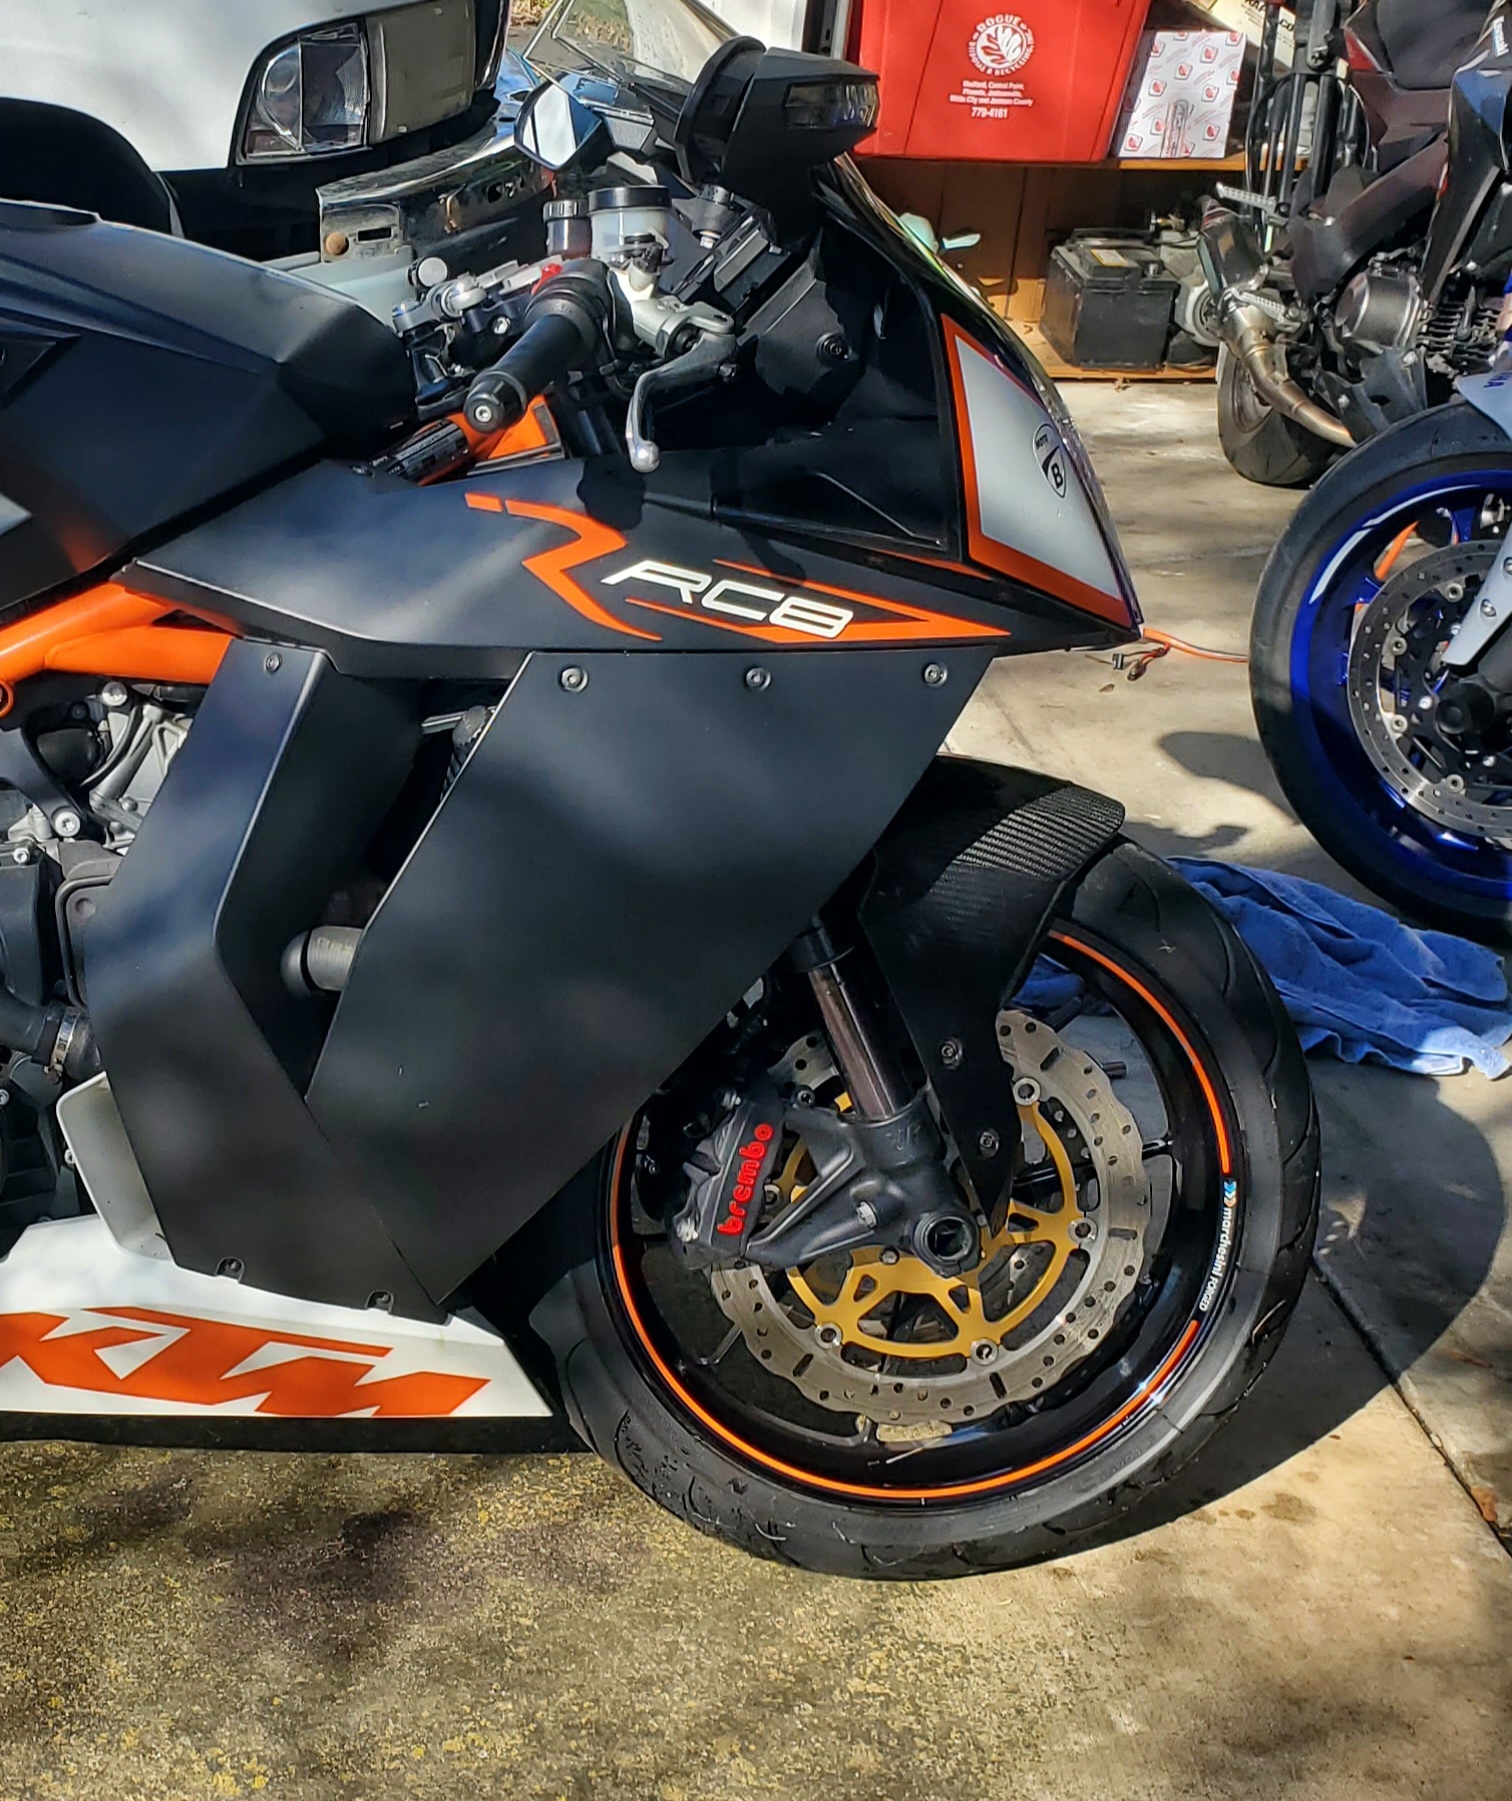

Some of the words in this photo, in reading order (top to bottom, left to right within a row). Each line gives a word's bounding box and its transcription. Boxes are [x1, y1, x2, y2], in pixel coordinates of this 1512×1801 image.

[976, 14, 1022, 32] ROGUE
[600, 559, 854, 638] RC8
[716, 1123, 774, 1236] brembo
[1199, 1276, 1219, 1312] FORGED
